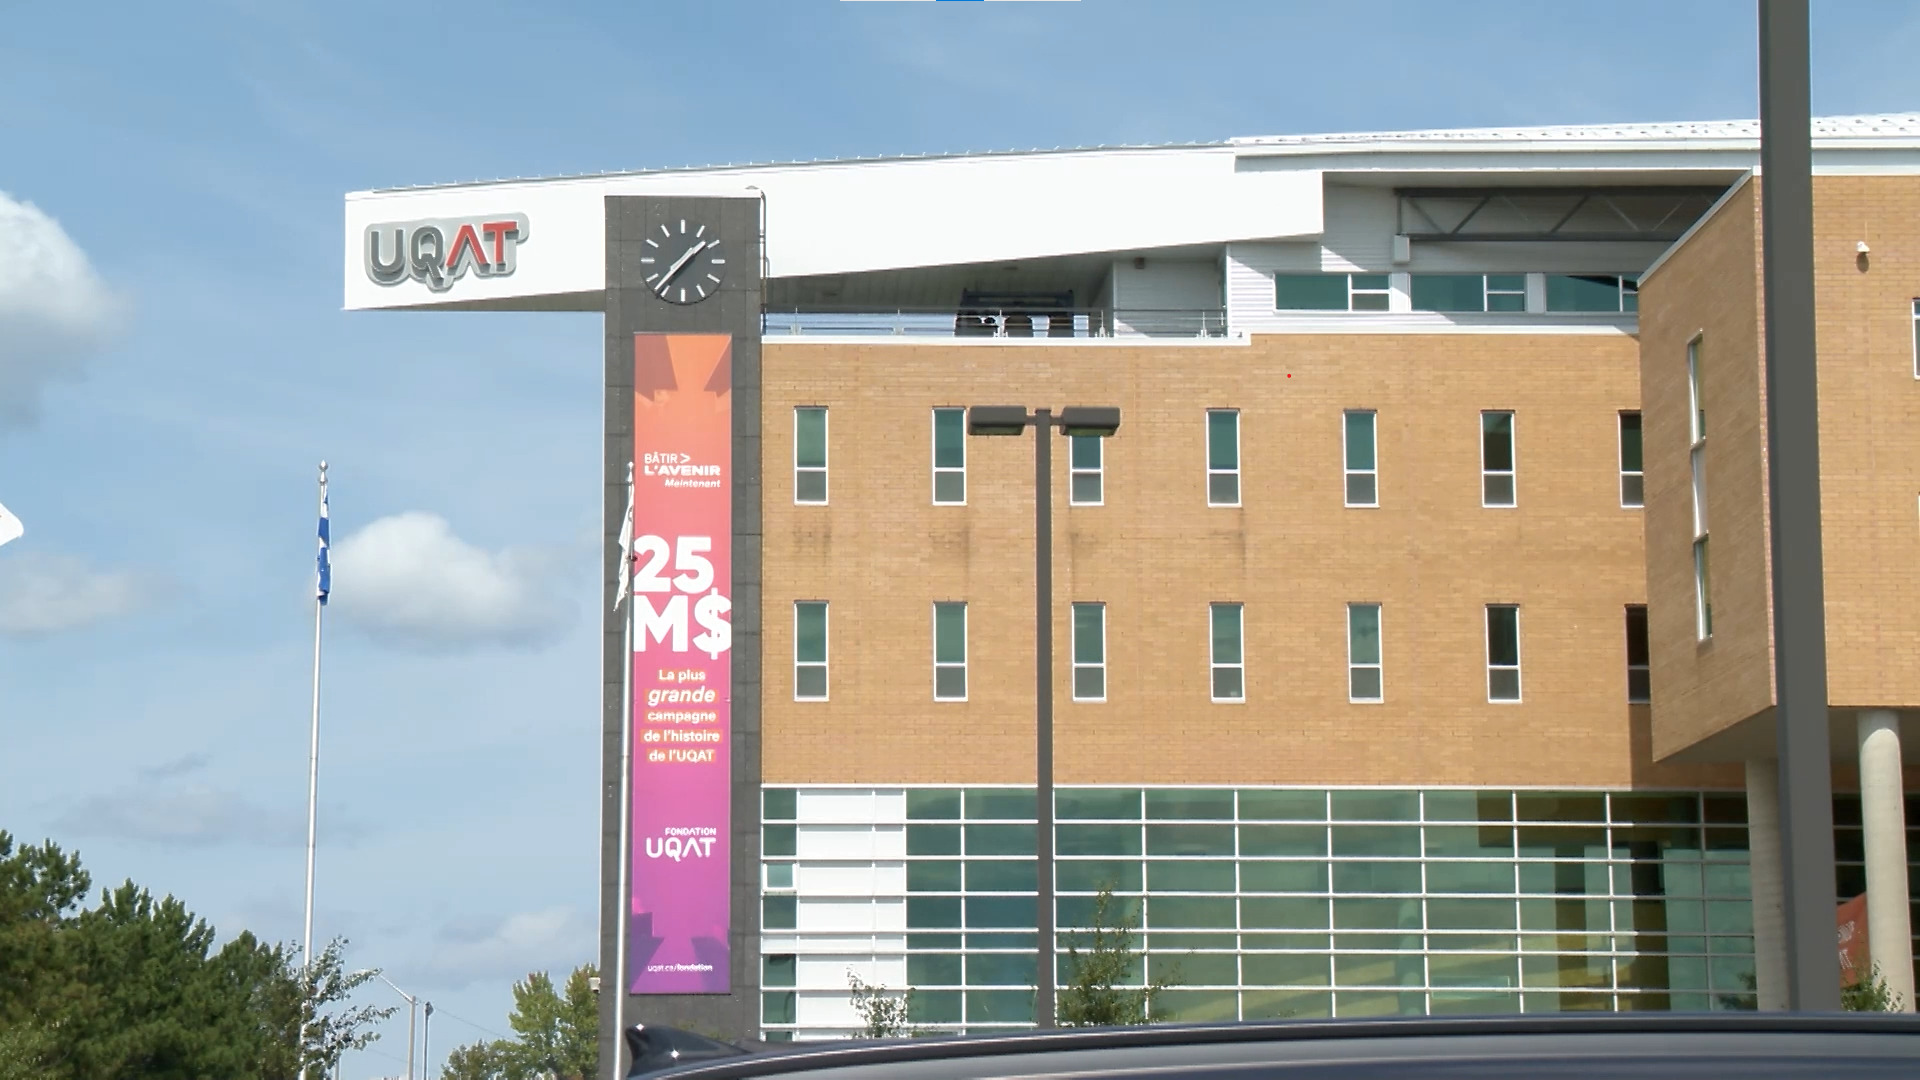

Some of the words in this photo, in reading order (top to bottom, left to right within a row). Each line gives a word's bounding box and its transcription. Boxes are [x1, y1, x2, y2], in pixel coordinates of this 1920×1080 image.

[369, 221, 517, 286] UQAT
[644, 464, 721, 476] L'AVENIR
[664, 478, 721, 488] Maintenant
[633, 534, 714, 594] 25
[633, 587, 732, 660] M$
[658, 669, 675, 680] La
[678, 669, 706, 684] plus
[648, 685, 716, 707] grande
[647, 711, 717, 724] campagne
[643, 729, 660, 742] de
[663, 729, 720, 742] l'histoire
[649, 749, 666, 762] de
[668, 749, 715, 763] l'UQAT
[665, 827, 717, 836] FONDATION
[645, 837, 717, 863] UQAT
